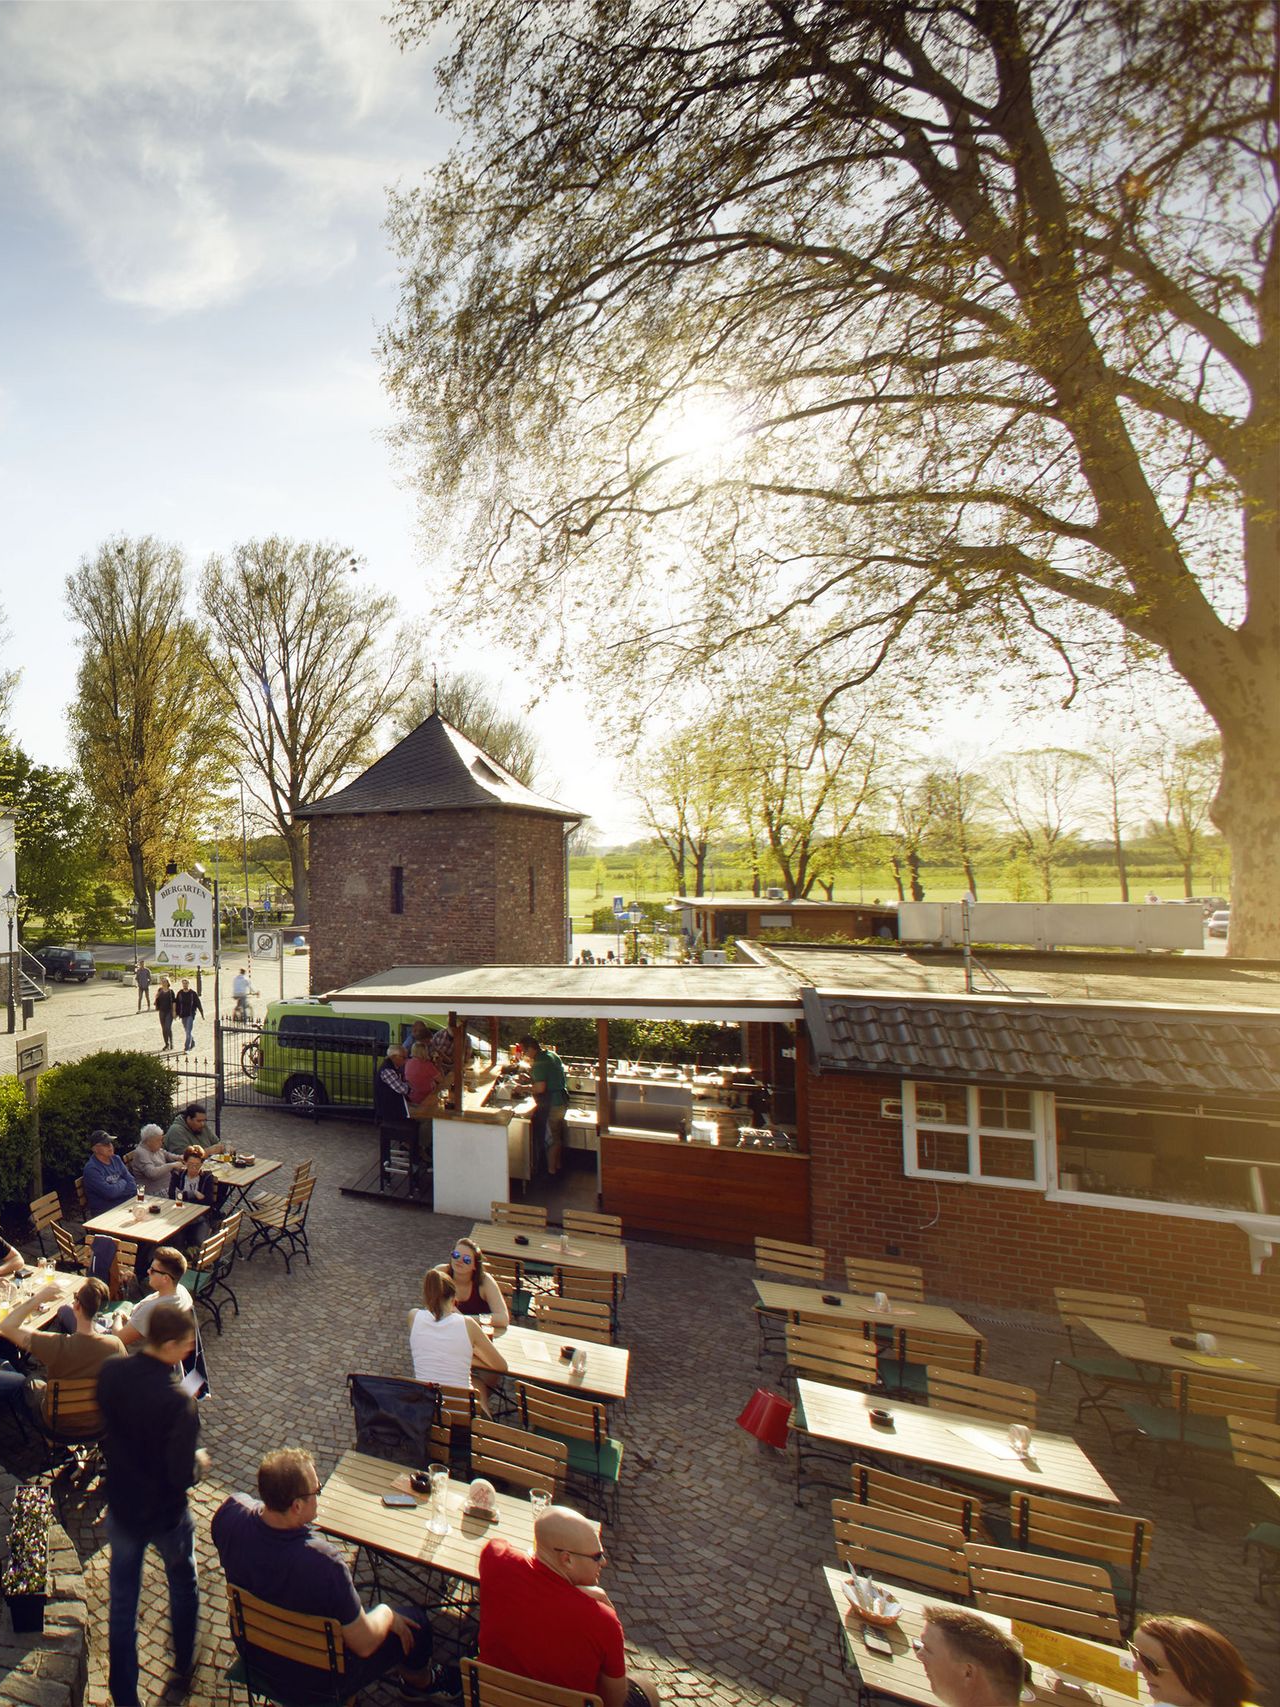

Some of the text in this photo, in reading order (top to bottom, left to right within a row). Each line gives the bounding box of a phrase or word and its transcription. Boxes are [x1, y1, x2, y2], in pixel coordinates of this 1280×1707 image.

[160, 885, 206, 899] BIERGARTEN
[173, 918, 193, 927] ZUR
[160, 928, 207, 938] ALTSTADT
[260, 938, 271, 946] 30
